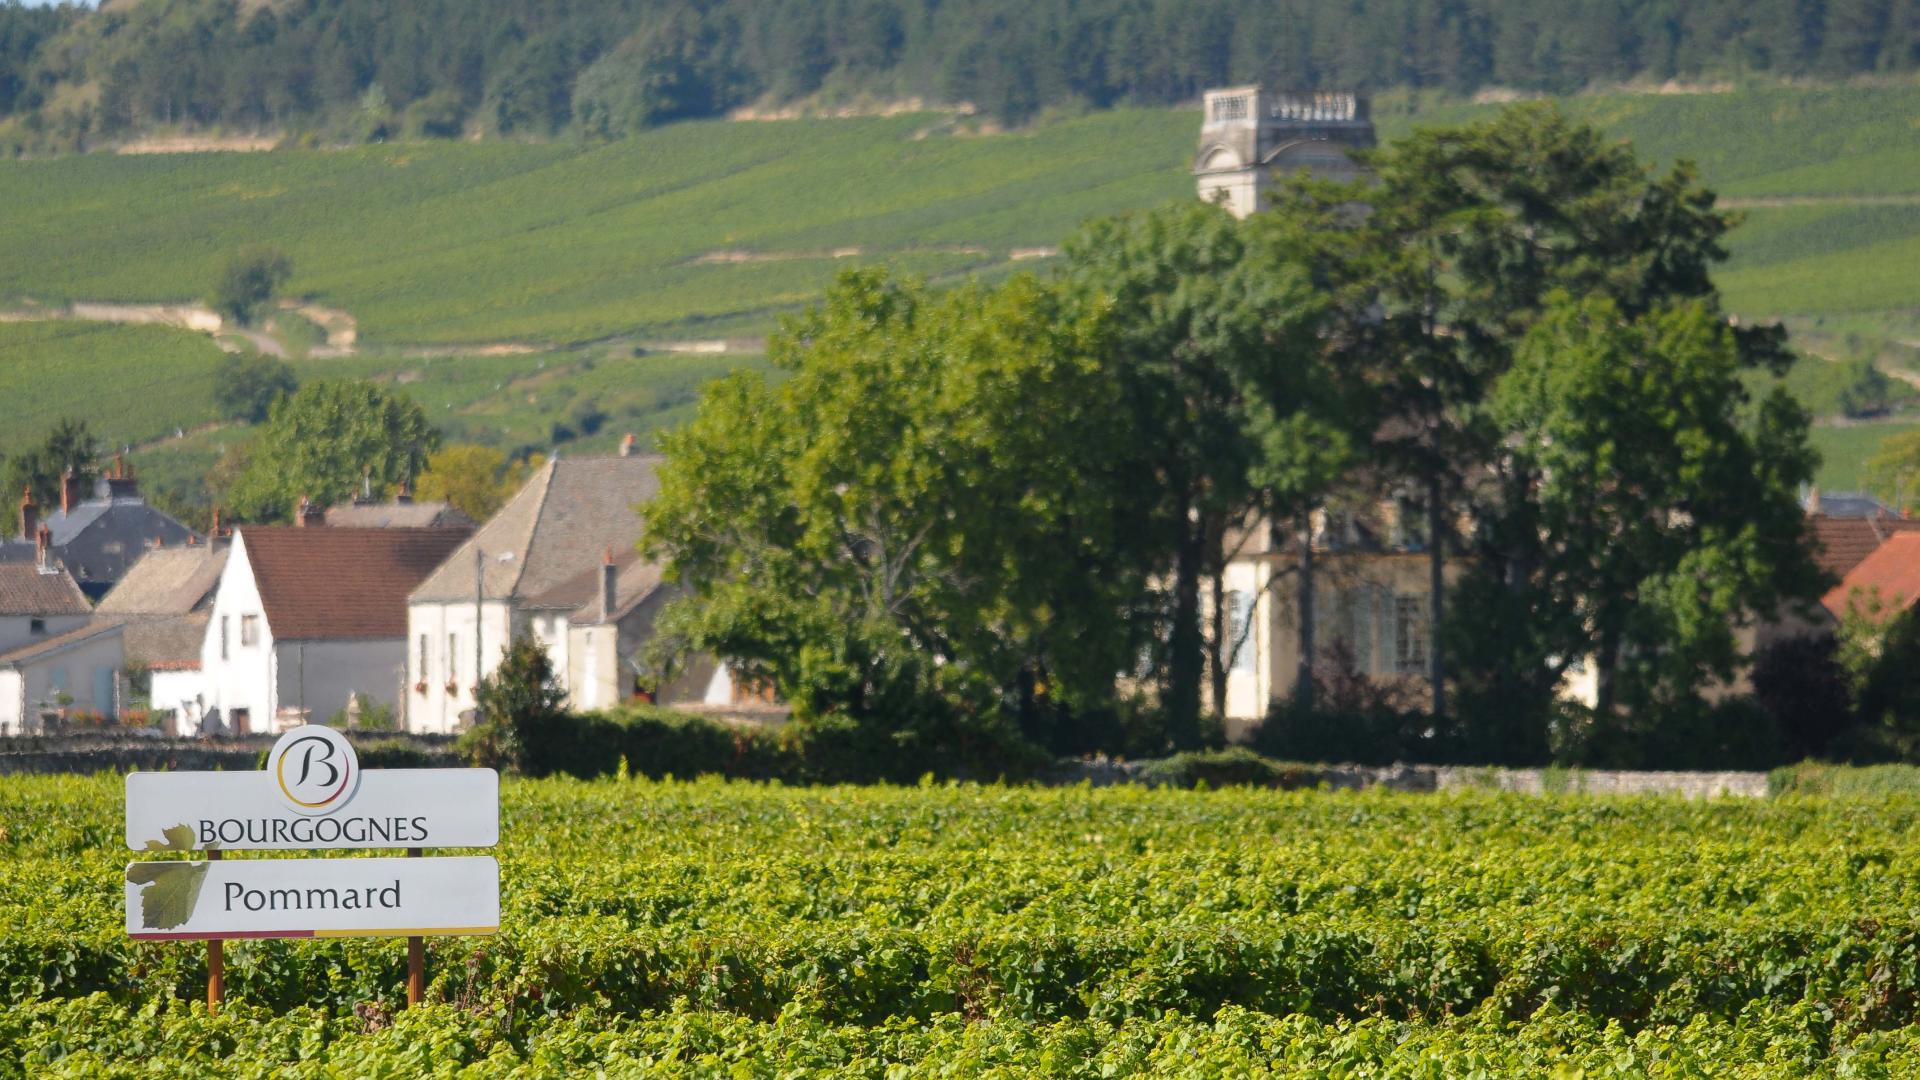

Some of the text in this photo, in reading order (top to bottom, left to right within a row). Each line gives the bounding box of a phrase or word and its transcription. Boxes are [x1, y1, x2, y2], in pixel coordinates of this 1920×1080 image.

[280, 735, 339, 787] B
[198, 816, 429, 844] BOURGOGNES
[224, 879, 402, 912] Pommard
